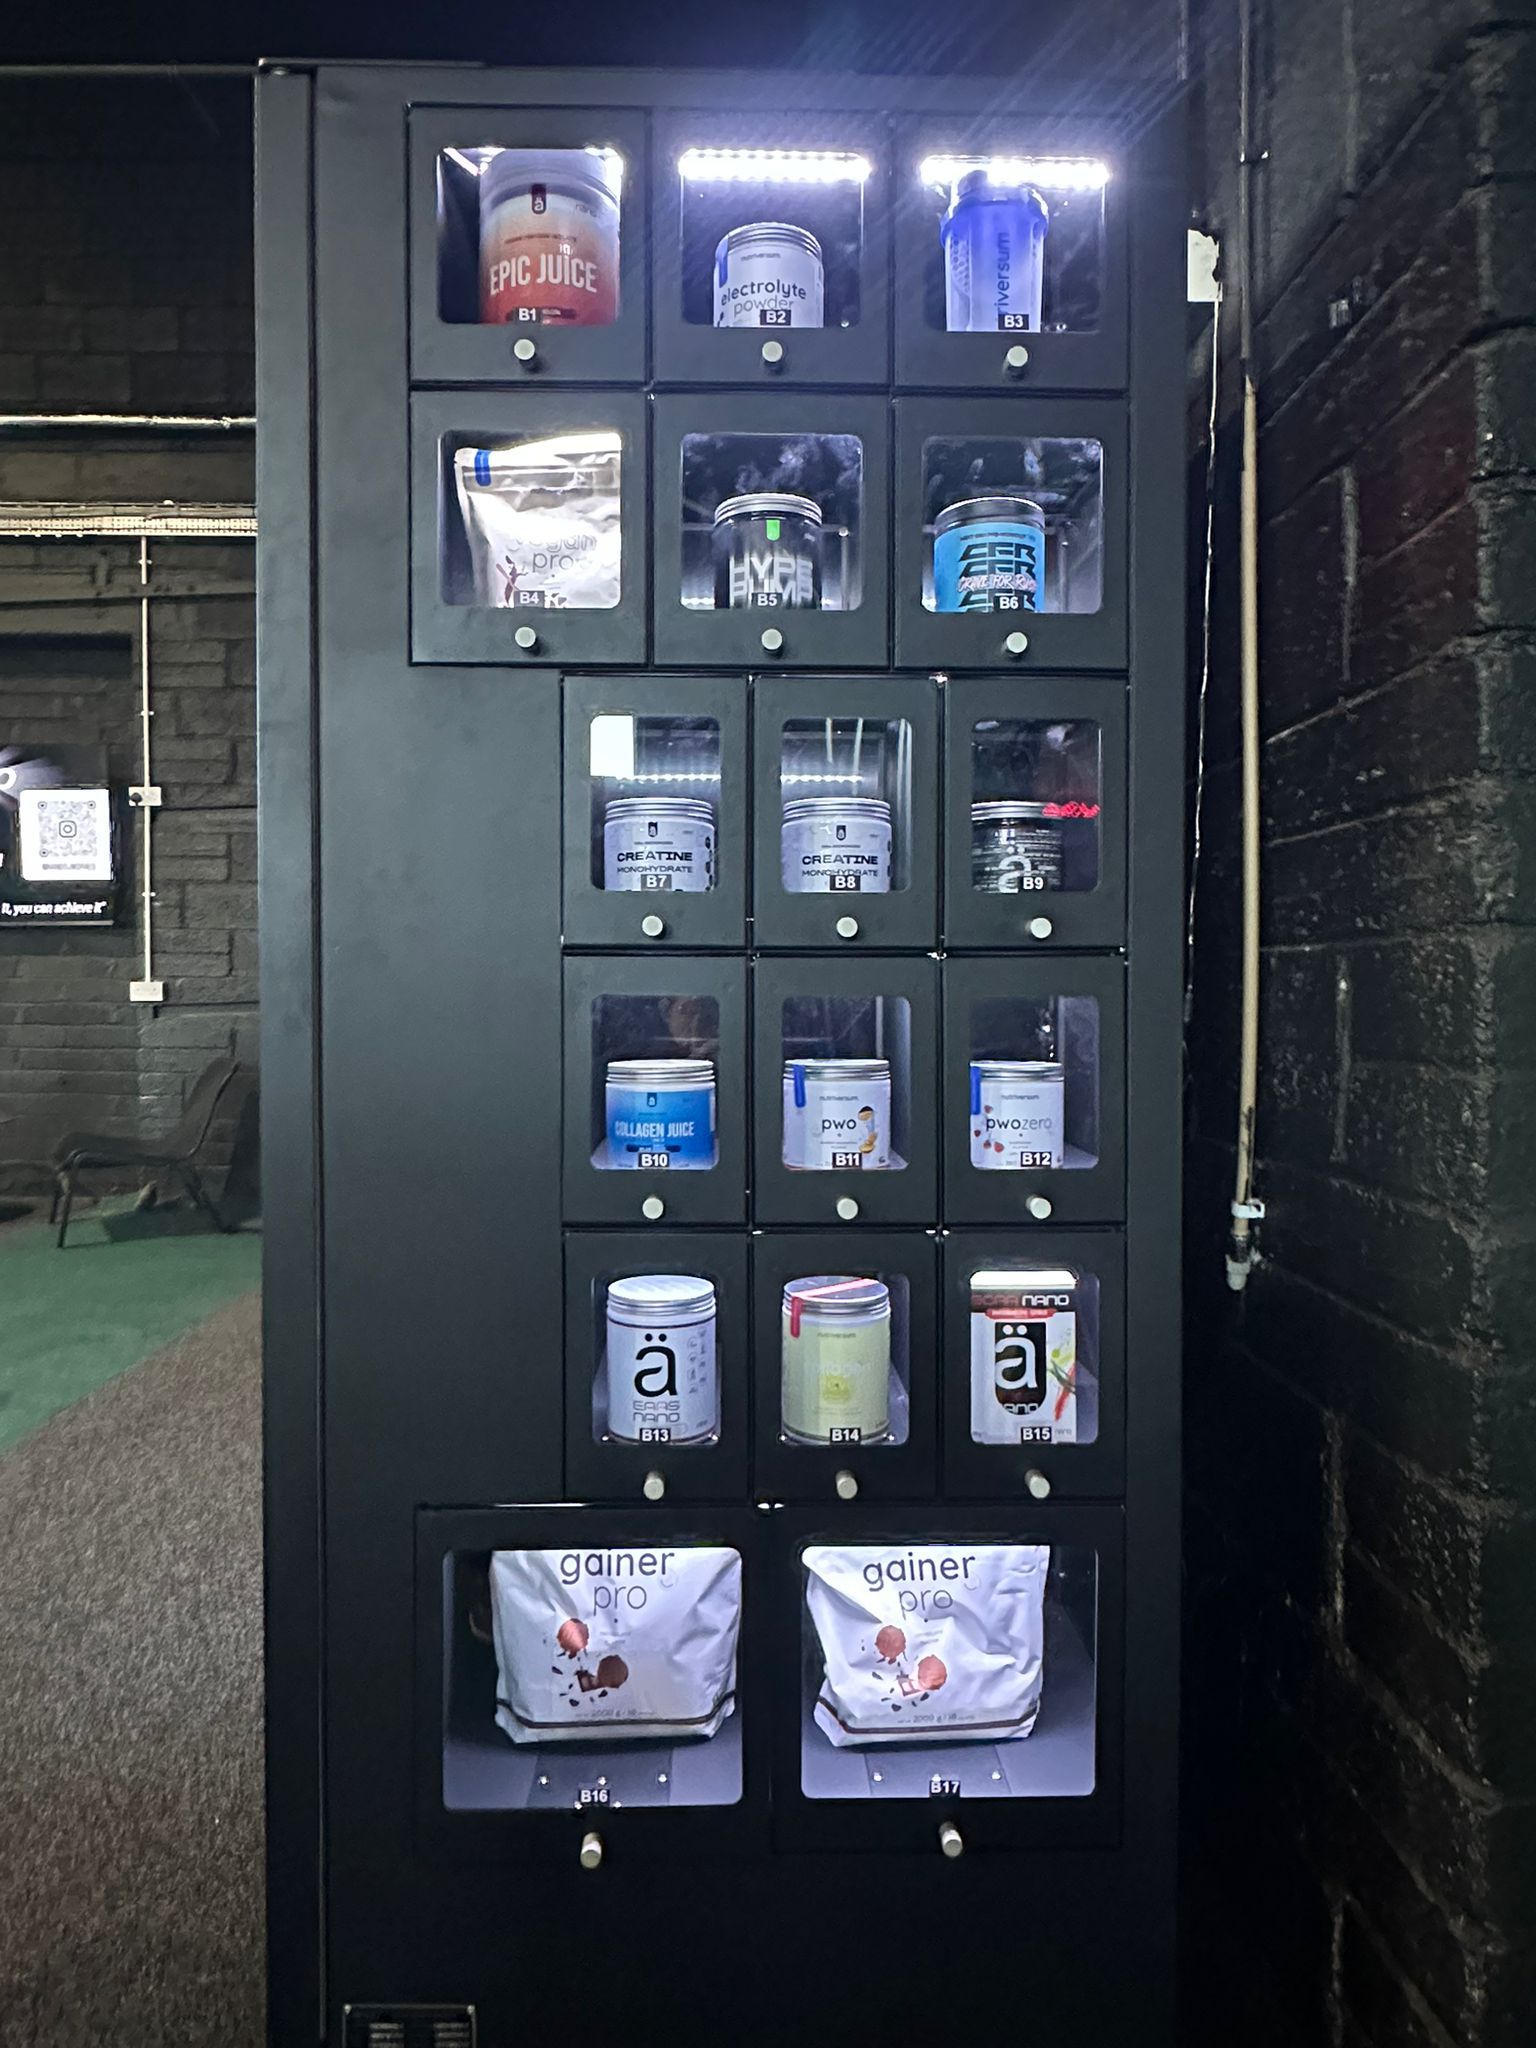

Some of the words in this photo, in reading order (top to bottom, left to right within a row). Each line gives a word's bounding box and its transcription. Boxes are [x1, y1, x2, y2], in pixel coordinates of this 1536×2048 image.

[490, 255, 531, 295] EPIC
[536, 253, 598, 293] JUICE
[721, 279, 807, 306] electrolyte
[733, 295, 794, 317] powder
[518, 308, 537, 321] B1
[766, 311, 787, 323] B2
[1004, 315, 1024, 328] B3
[532, 551, 574, 573] pro
[519, 592, 540, 604] B4
[757, 593, 778, 606] B5
[999, 596, 1019, 609] B6
[617, 851, 693, 862] CREATINE
[801, 855, 878, 865] CREATINE
[617, 865, 693, 873] MONOHYDRATE
[646, 875, 667, 888] B7
[835, 876, 856, 889] B8
[1022, 877, 1044, 890] B9
[13, 905, 33, 917] you
[33, 904, 53, 914] can
[53, 901, 93, 914] achieve
[615, 1121, 665, 1138] COLLAGEN
[666, 1121, 695, 1137] JUICE
[822, 1119, 857, 1133] pwo
[986, 1118, 1053, 1132] pwozero
[641, 1153, 668, 1167] B10
[835, 1153, 860, 1166] B11
[1022, 1152, 1051, 1166] B12
[995, 1324, 1038, 1390] ä
[634, 1333, 678, 1398] ä
[641, 1429, 669, 1442] B13
[831, 1429, 859, 1442] B14
[1022, 1427, 1050, 1440] B15
[559, 1549, 675, 1585] gainer
[862, 1551, 976, 1592] gainer
[592, 1585, 647, 1616] pro
[899, 1588, 954, 1620] pro
[930, 1781, 960, 1794] B17
[580, 1791, 608, 1803] B16
